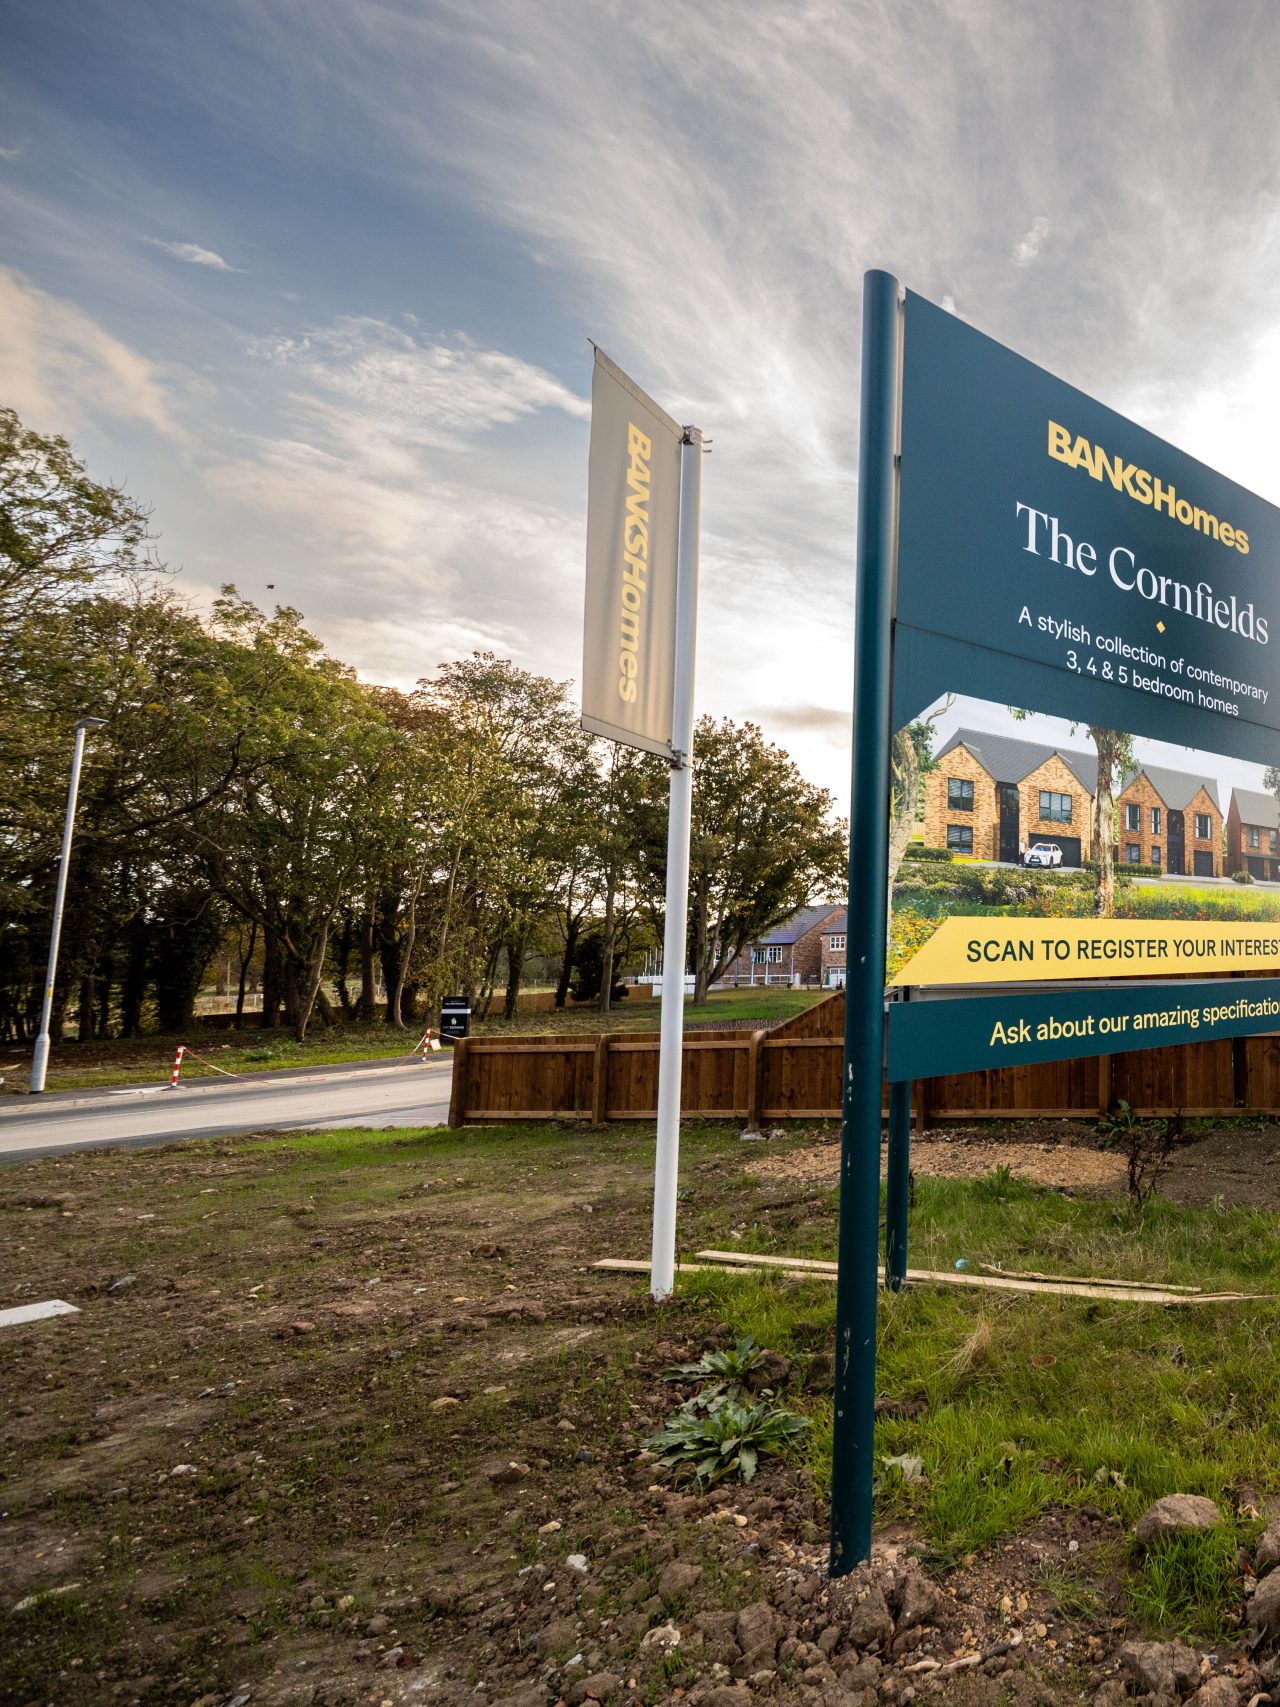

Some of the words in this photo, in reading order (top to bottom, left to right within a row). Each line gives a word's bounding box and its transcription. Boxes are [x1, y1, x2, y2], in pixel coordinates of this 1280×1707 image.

[1047, 419, 1250, 555] BANKSHomes
[619, 422, 652, 705] BANKSHomes
[1016, 500, 1097, 576] The
[1108, 546, 1269, 645] Cornfields
[1017, 605, 1033, 628] A
[1037, 615, 1091, 646] stylish
[1095, 635, 1167, 670] collection
[1170, 658, 1185, 675] of
[1186, 665, 1269, 705] contemporary
[1066, 650, 1082, 675] 3,
[1086, 657, 1098, 676] 4
[1101, 661, 1114, 681] &
[1118, 665, 1128, 684] 5
[1132, 669, 1194, 704] bedroom
[1198, 689, 1239, 717] homes
[966, 939, 1034, 963] SCAN
[1040, 939, 1071, 961] TO
[1077, 939, 1169, 960] REGISTER
[1172, 938, 1217, 958] YOUR
[989, 1018, 1032, 1047] Ask
[1036, 1015, 1095, 1041] about
[1098, 1014, 1130, 1034] our
[1132, 1005, 1200, 1029] amazing
